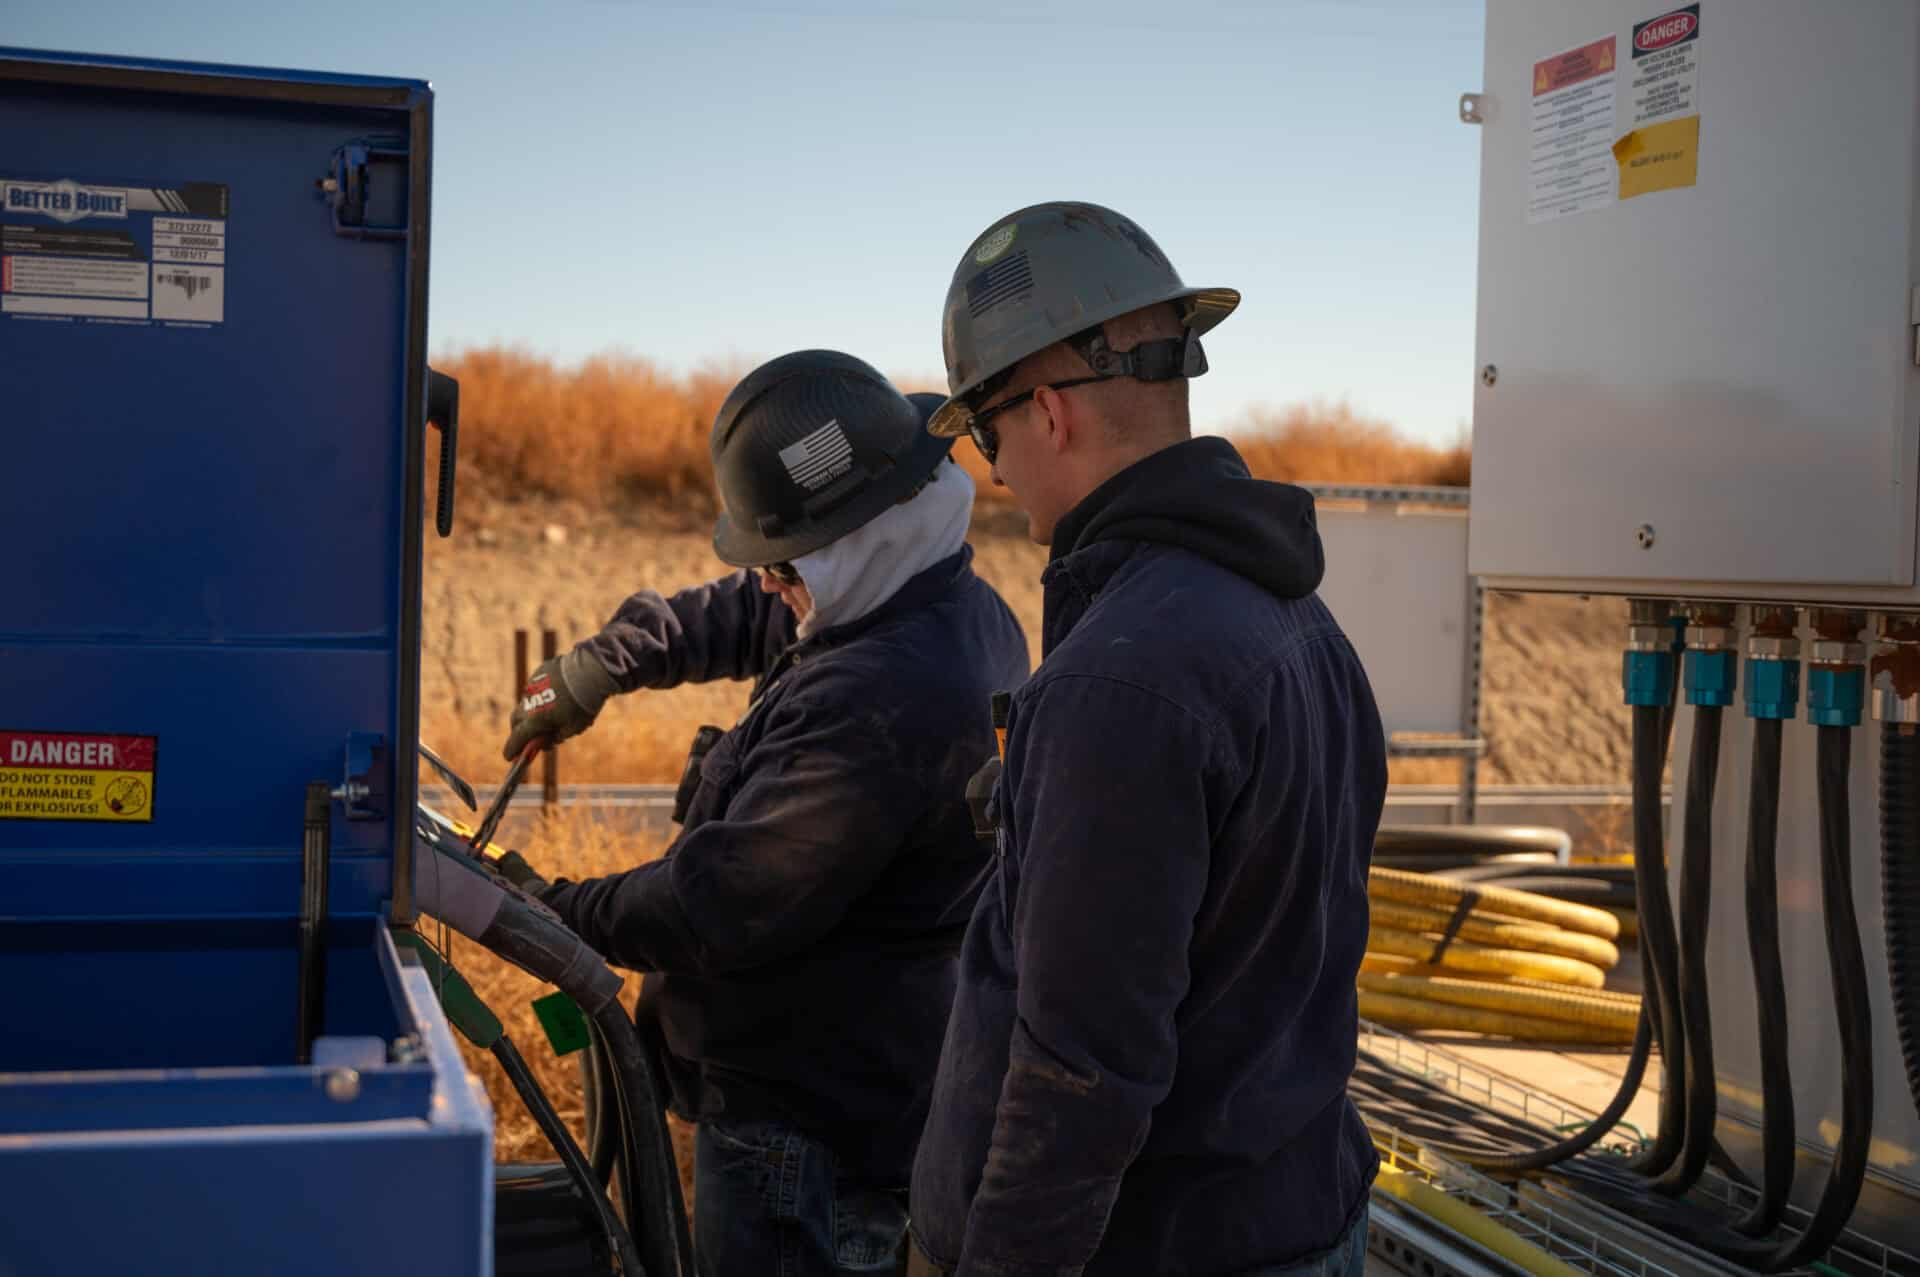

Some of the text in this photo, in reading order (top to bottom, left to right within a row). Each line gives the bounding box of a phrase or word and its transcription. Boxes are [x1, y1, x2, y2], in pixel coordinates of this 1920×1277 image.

[1642, 16, 1689, 45] DANGER
[11, 739, 115, 766] DANGER
[0, 772, 97, 786] DO NOT STORE
[1, 786, 93, 800] FLAMMABLES
[15, 801, 99, 814] EXPLOSIVES!
